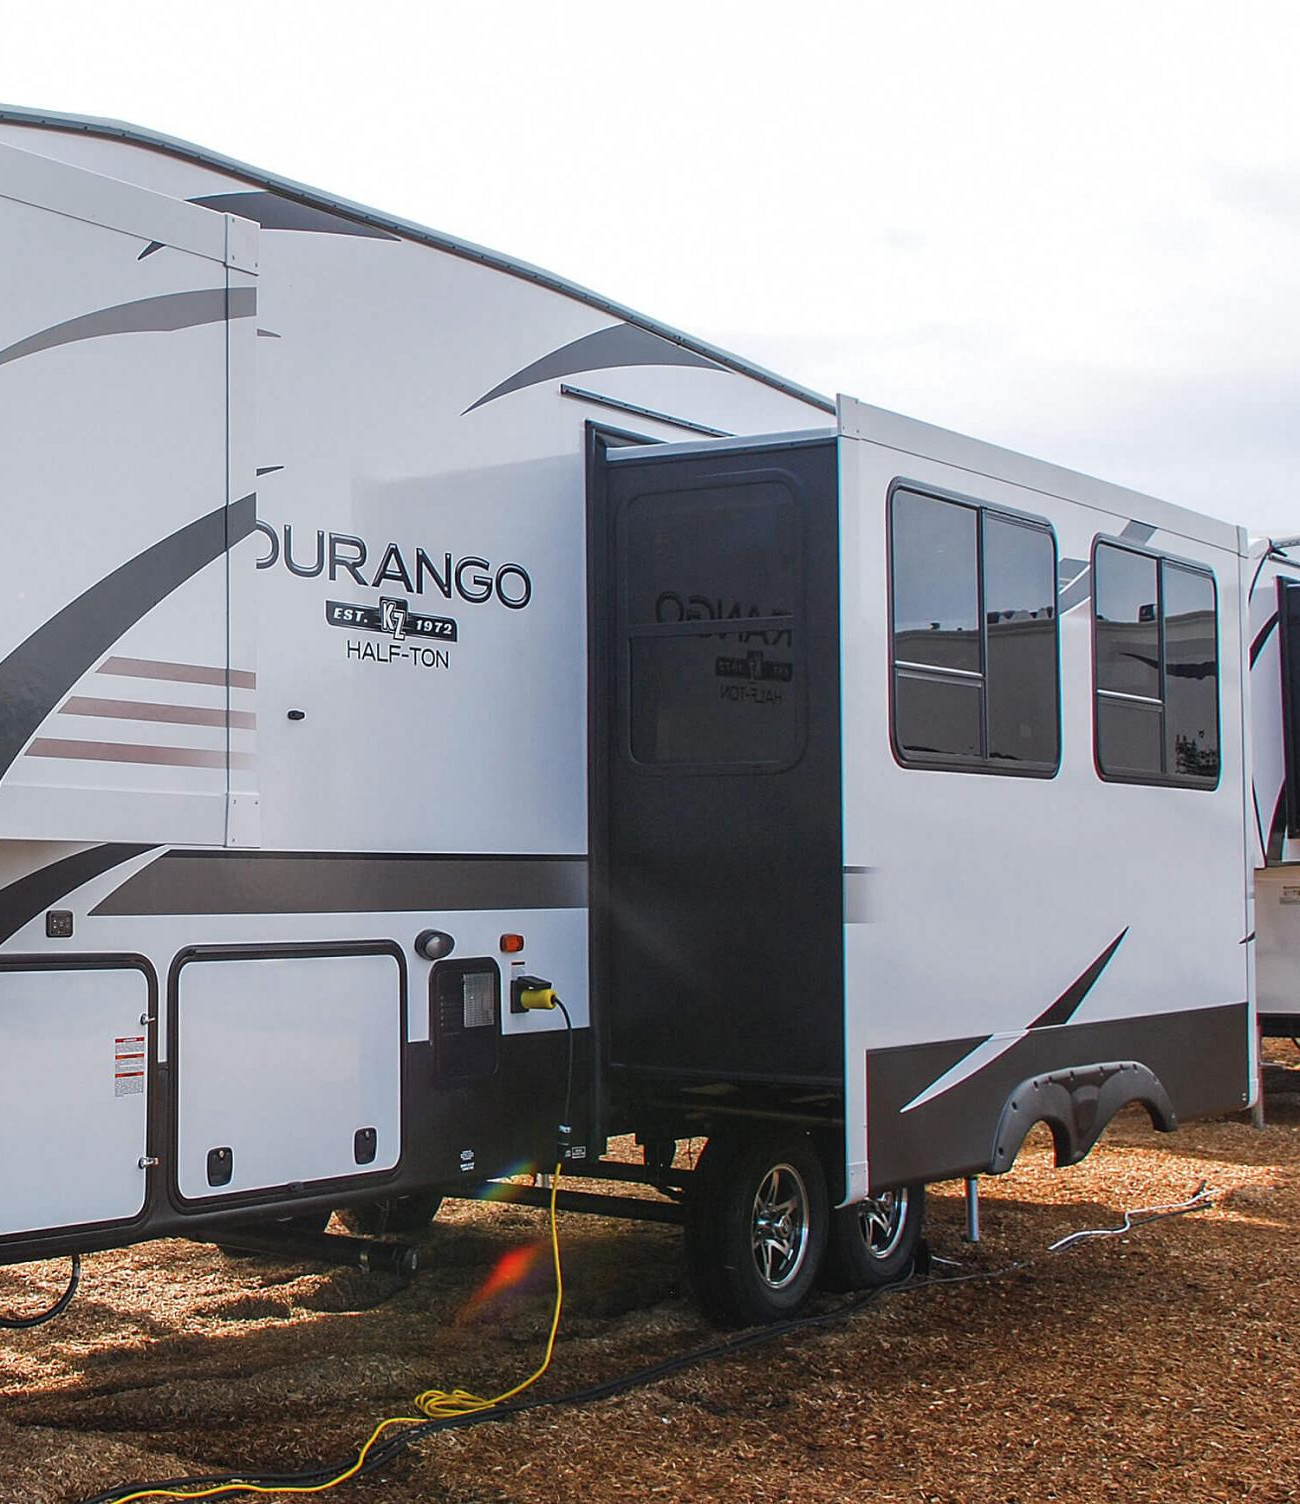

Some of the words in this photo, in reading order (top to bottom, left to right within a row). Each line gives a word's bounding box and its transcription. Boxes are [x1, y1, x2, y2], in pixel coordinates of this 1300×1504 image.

[333, 607, 368, 623] EST.
[380, 600, 406, 640] KZ
[415, 619, 453, 635] 1972
[346, 640, 449, 669] HALF-TON
